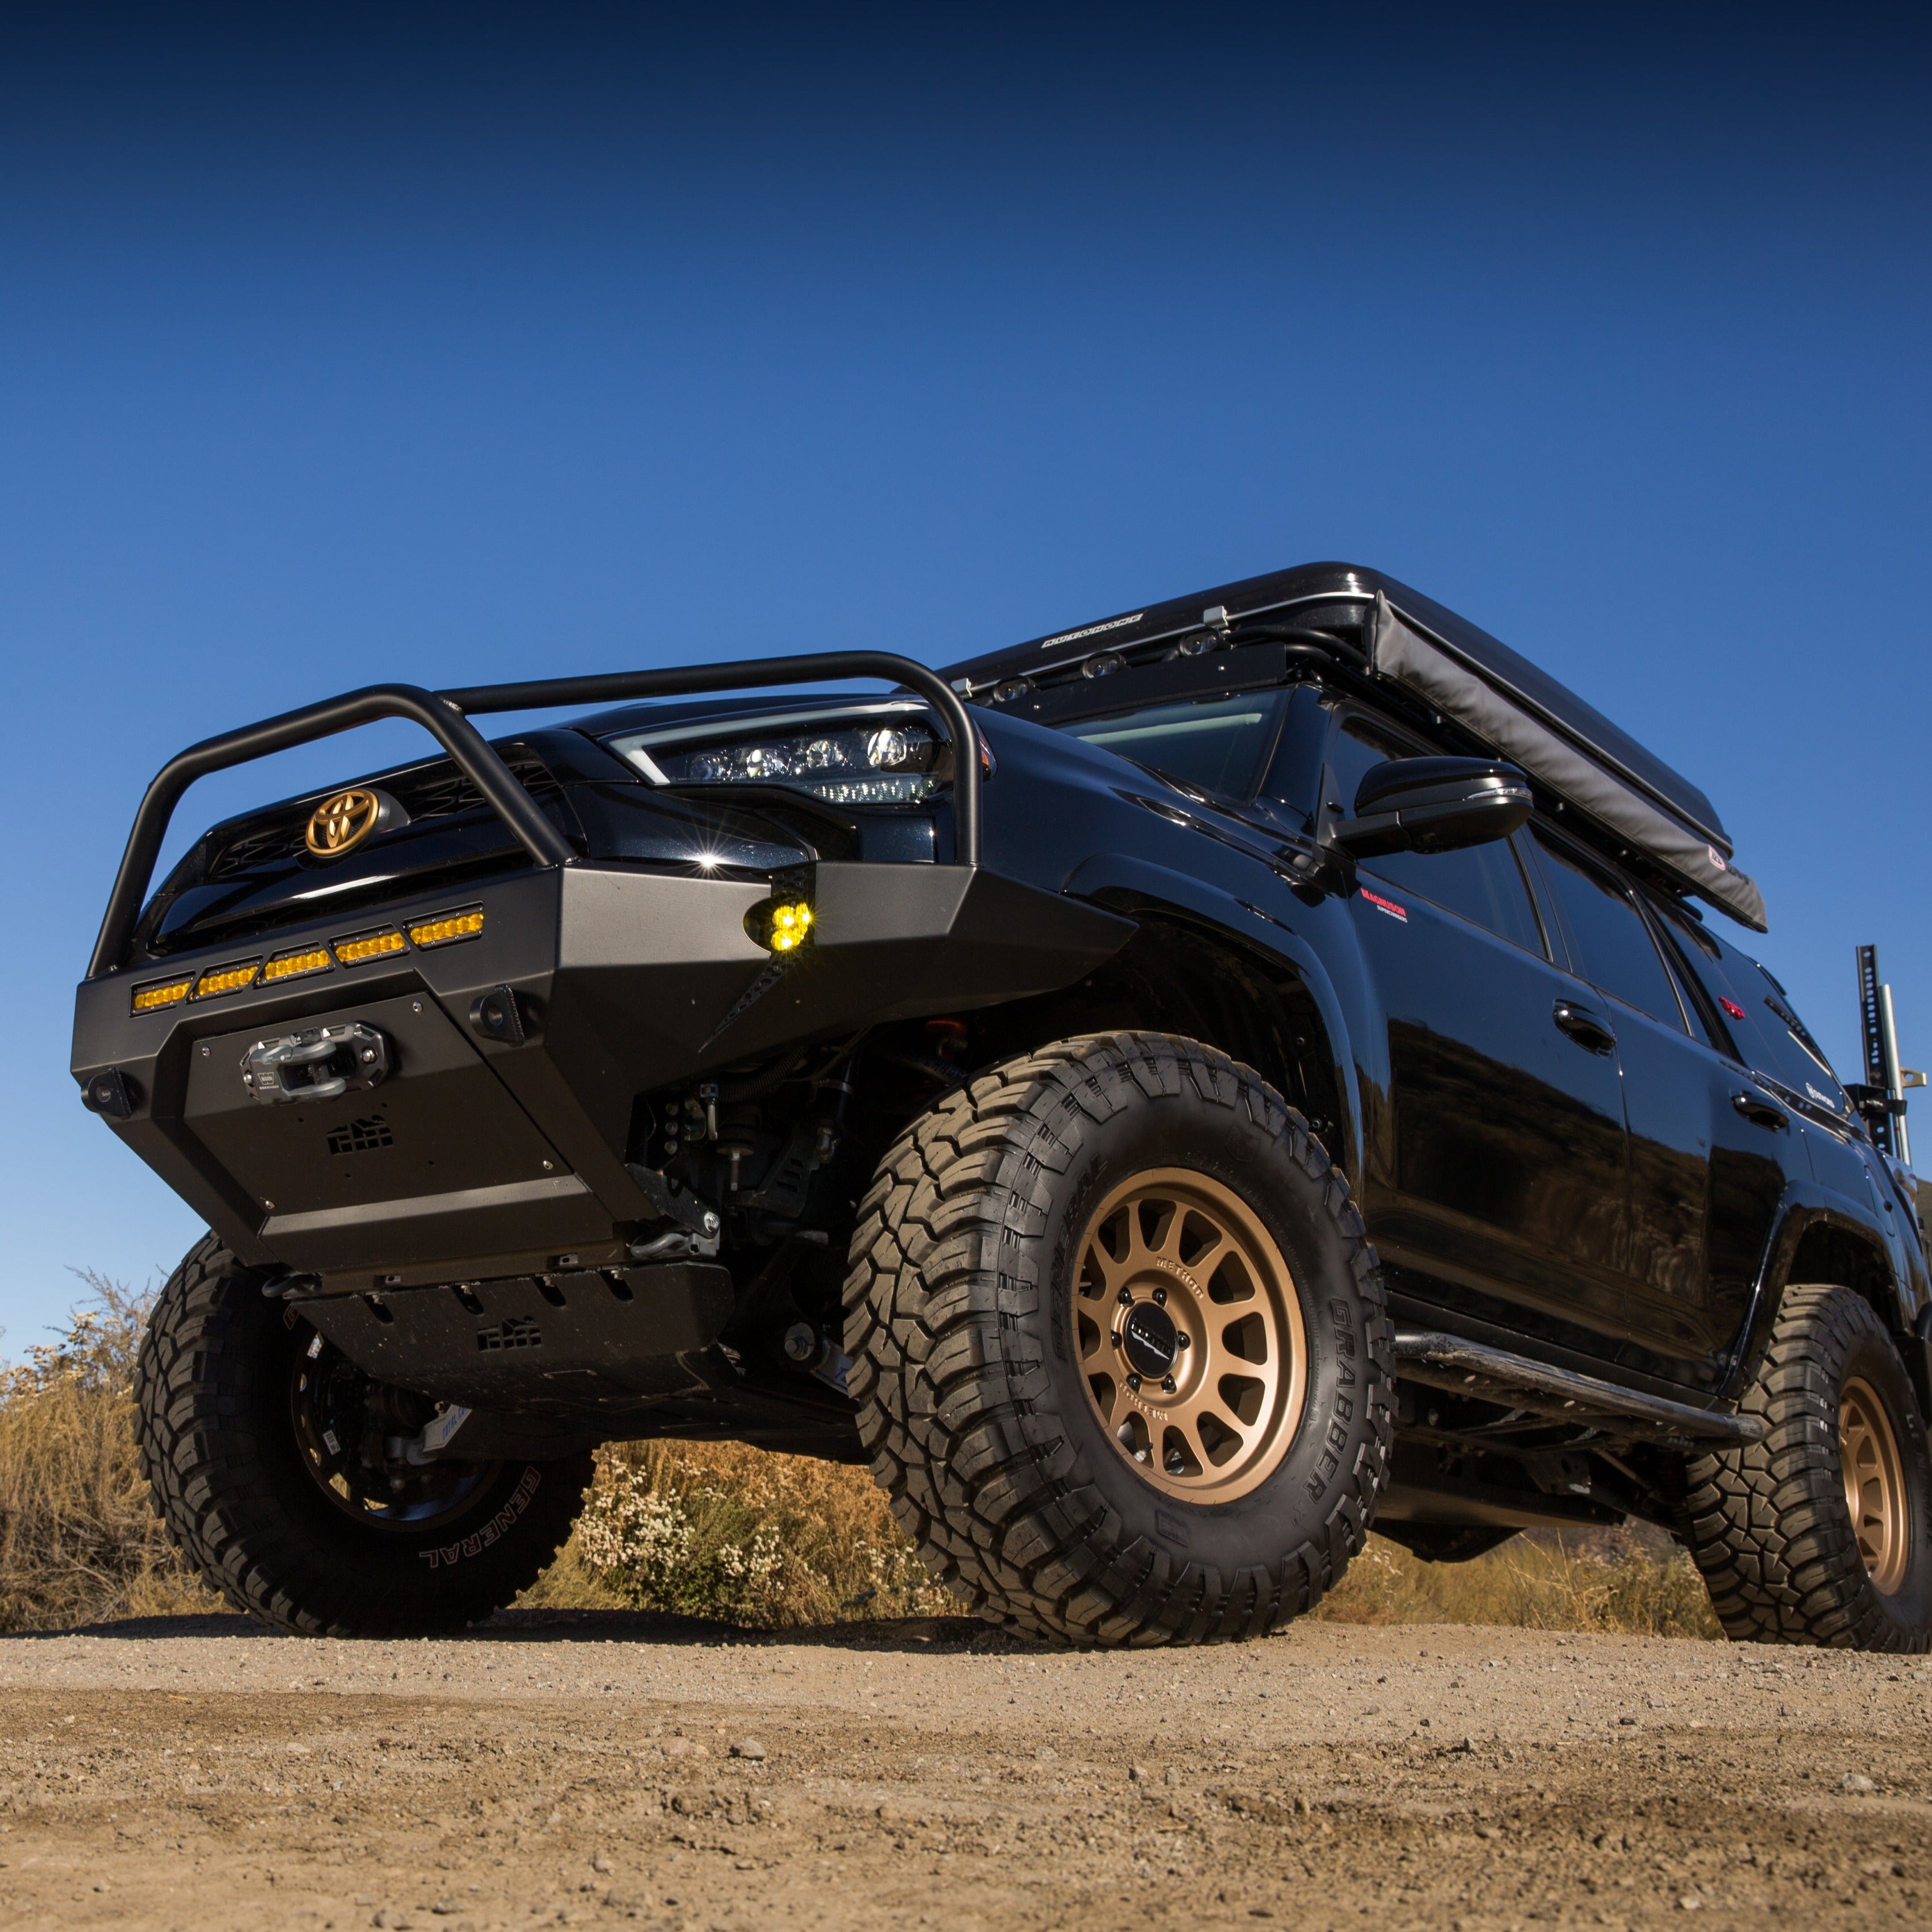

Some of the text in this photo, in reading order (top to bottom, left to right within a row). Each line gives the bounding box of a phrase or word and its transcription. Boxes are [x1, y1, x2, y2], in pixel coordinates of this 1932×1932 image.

[1360, 887, 1406, 917] MAGNUSON
[1050, 1153, 1108, 1362] GENERAL
[1156, 1256, 1204, 1299] METHOD
[1119, 1379, 1169, 1421] METHOD
[1303, 1297, 1358, 1505] GRABBER
[419, 1465, 541, 1569] GENERAL
